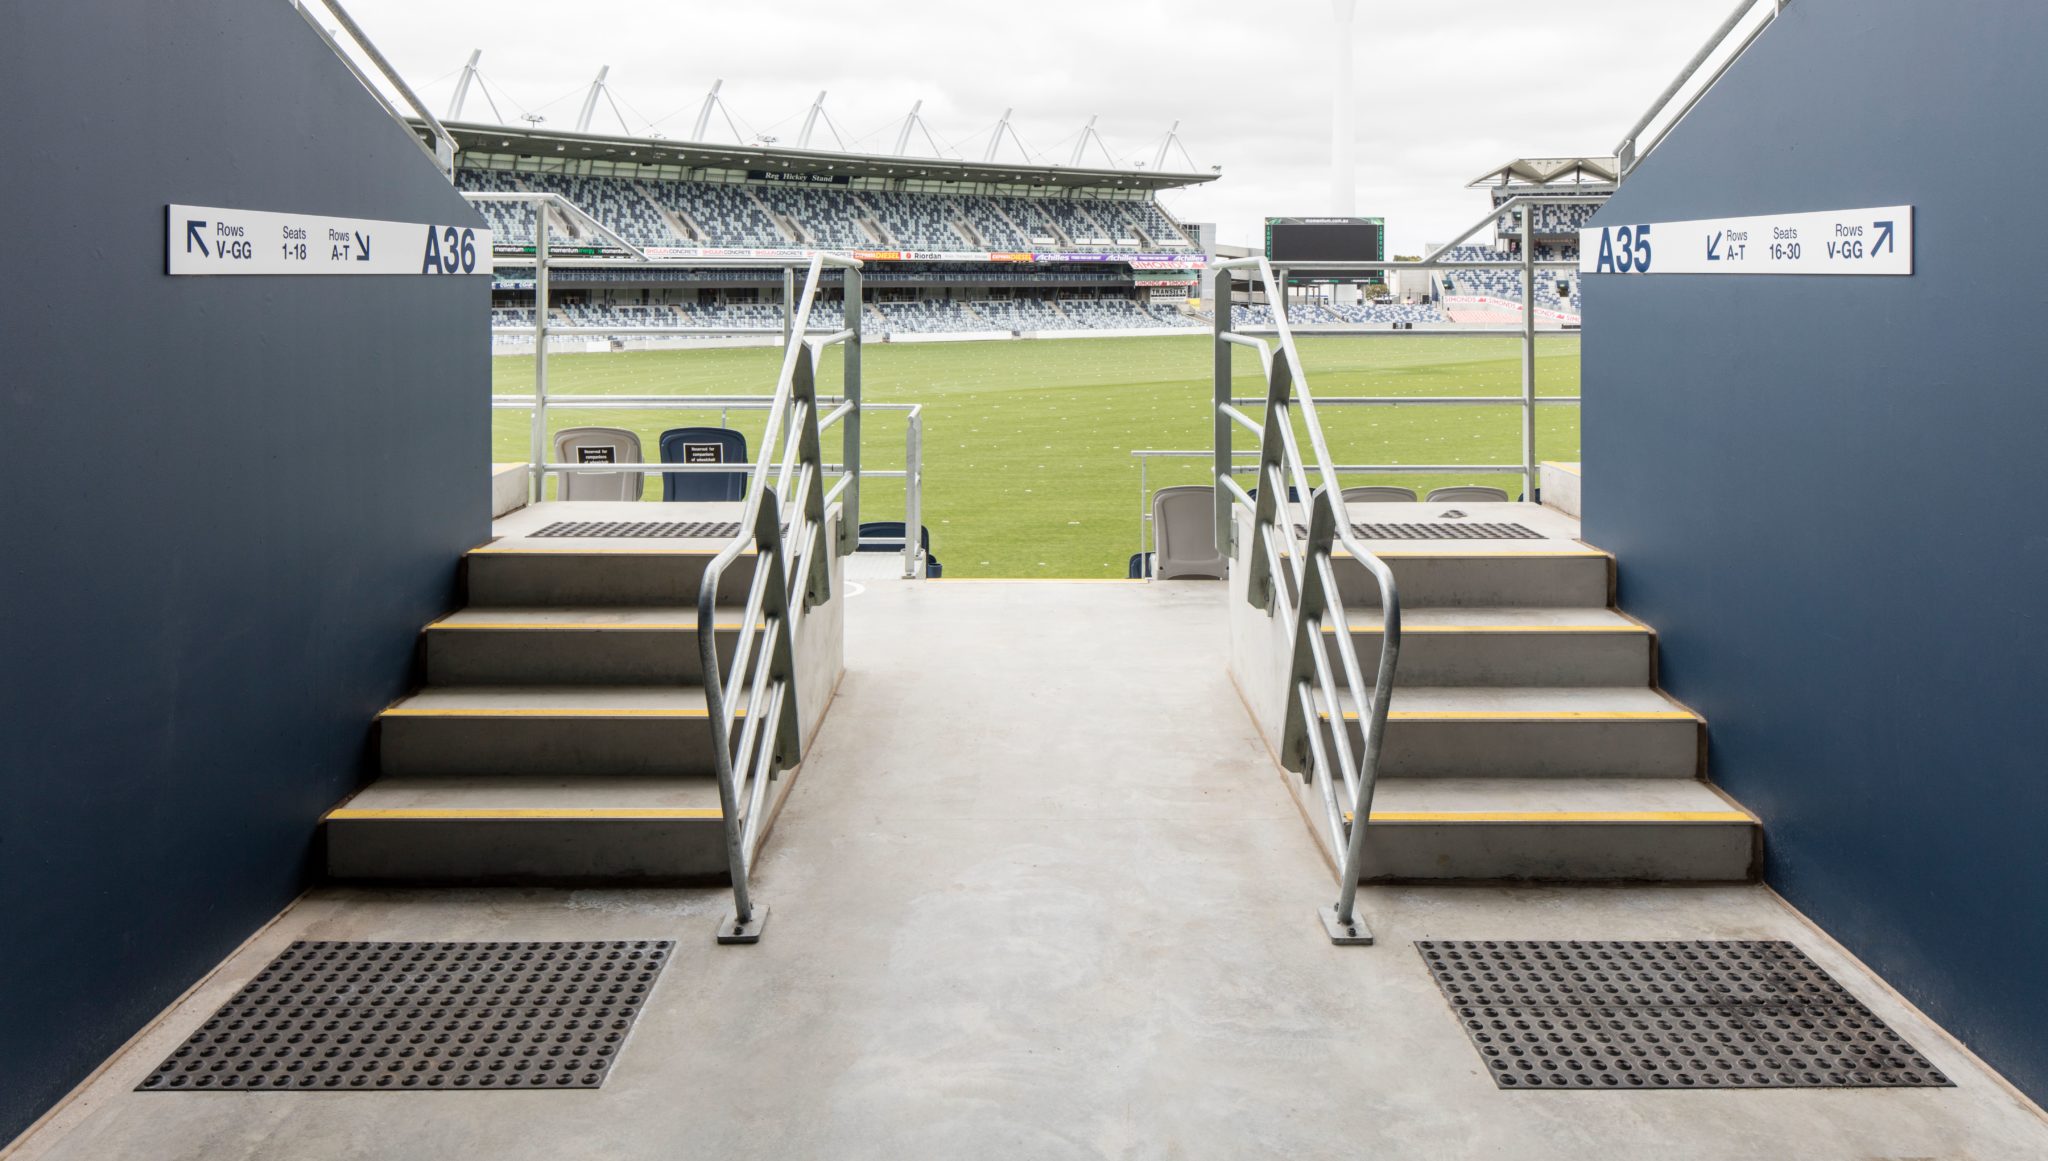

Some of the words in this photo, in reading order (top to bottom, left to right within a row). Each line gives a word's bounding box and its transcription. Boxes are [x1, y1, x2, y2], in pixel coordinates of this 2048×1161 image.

[765, 172, 780, 181] Reg
[783, 173, 807, 182] Hickey
[812, 174, 833, 182] Stand
[216, 222, 244, 237] Rows
[282, 226, 307, 240] Seats
[328, 228, 350, 242] Rows
[1726, 229, 1748, 242] Rows
[1772, 226, 1798, 240] Seats
[1835, 223, 1863, 237] Rows
[216, 240, 252, 259] V-GG
[282, 244, 307, 260] 1-18
[331, 244, 350, 261] A-T
[422, 225, 476, 274] A36
[914, 252, 942, 260] Riordan
[1596, 224, 1652, 273] A35
[1726, 244, 1746, 261] A-T
[1769, 243, 1801, 260] 16-30
[1826, 240, 1863, 259] V-GG
[1131, 261, 1188, 269] SIMONDS
